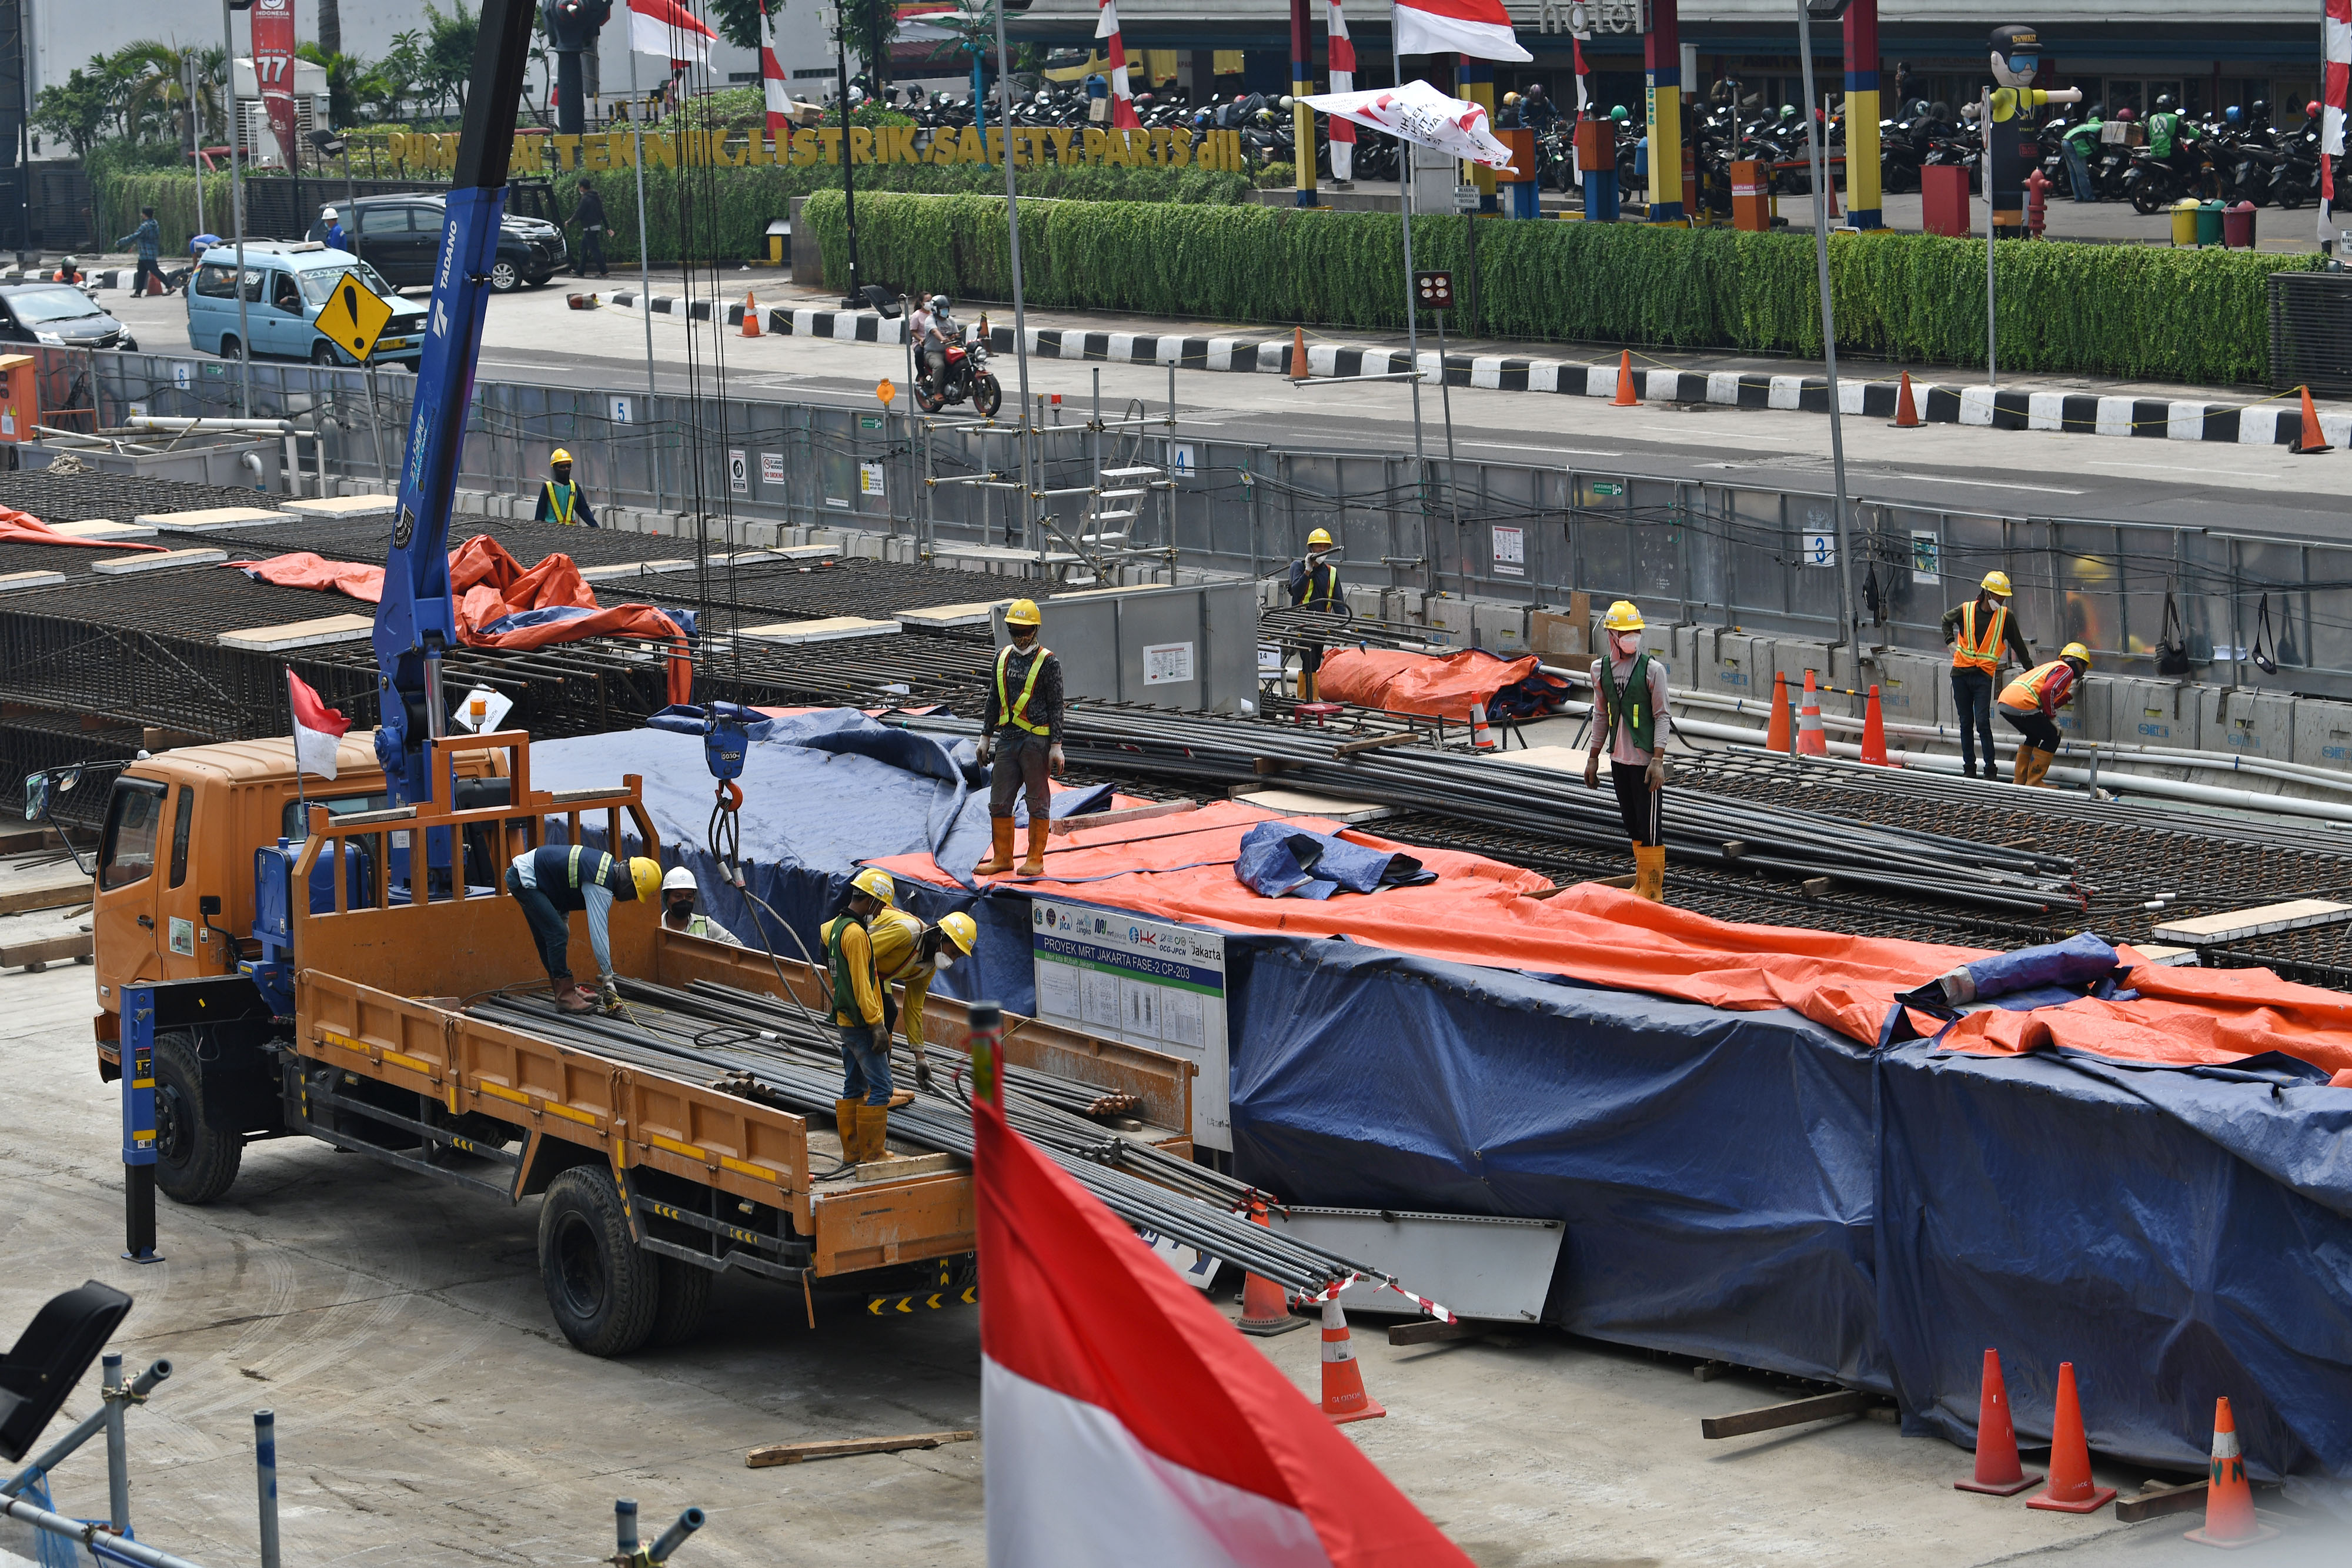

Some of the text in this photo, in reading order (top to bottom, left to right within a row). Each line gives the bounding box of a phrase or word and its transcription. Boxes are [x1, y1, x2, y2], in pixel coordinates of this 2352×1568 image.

[1539, 0, 1644, 34] hotel
[256, 56, 287, 82] 77
[388, 132, 462, 170] PUSA
[439, 220, 457, 290] TADANO
[179, 369, 185, 387] 6
[618, 403, 625, 423] 5
[1177, 451, 1185, 474] 4
[1816, 537, 1825, 564] 3
[486, 709, 499, 724] SOUTH
[2149, 725, 2169, 737] BETON
[1076, 917, 1084, 926] Jak
[1076, 927, 1091, 936] Lingko
[1044, 937, 1077, 955] PROYEK
[1078, 944, 1095, 959] MRT
[1097, 949, 1131, 967] JAKARTA
[1132, 956, 1160, 973] FASE-2
[1161, 962, 1190, 979] CP-203
[1045, 952, 1095, 969] Mari kita #Ubah Jakarta
